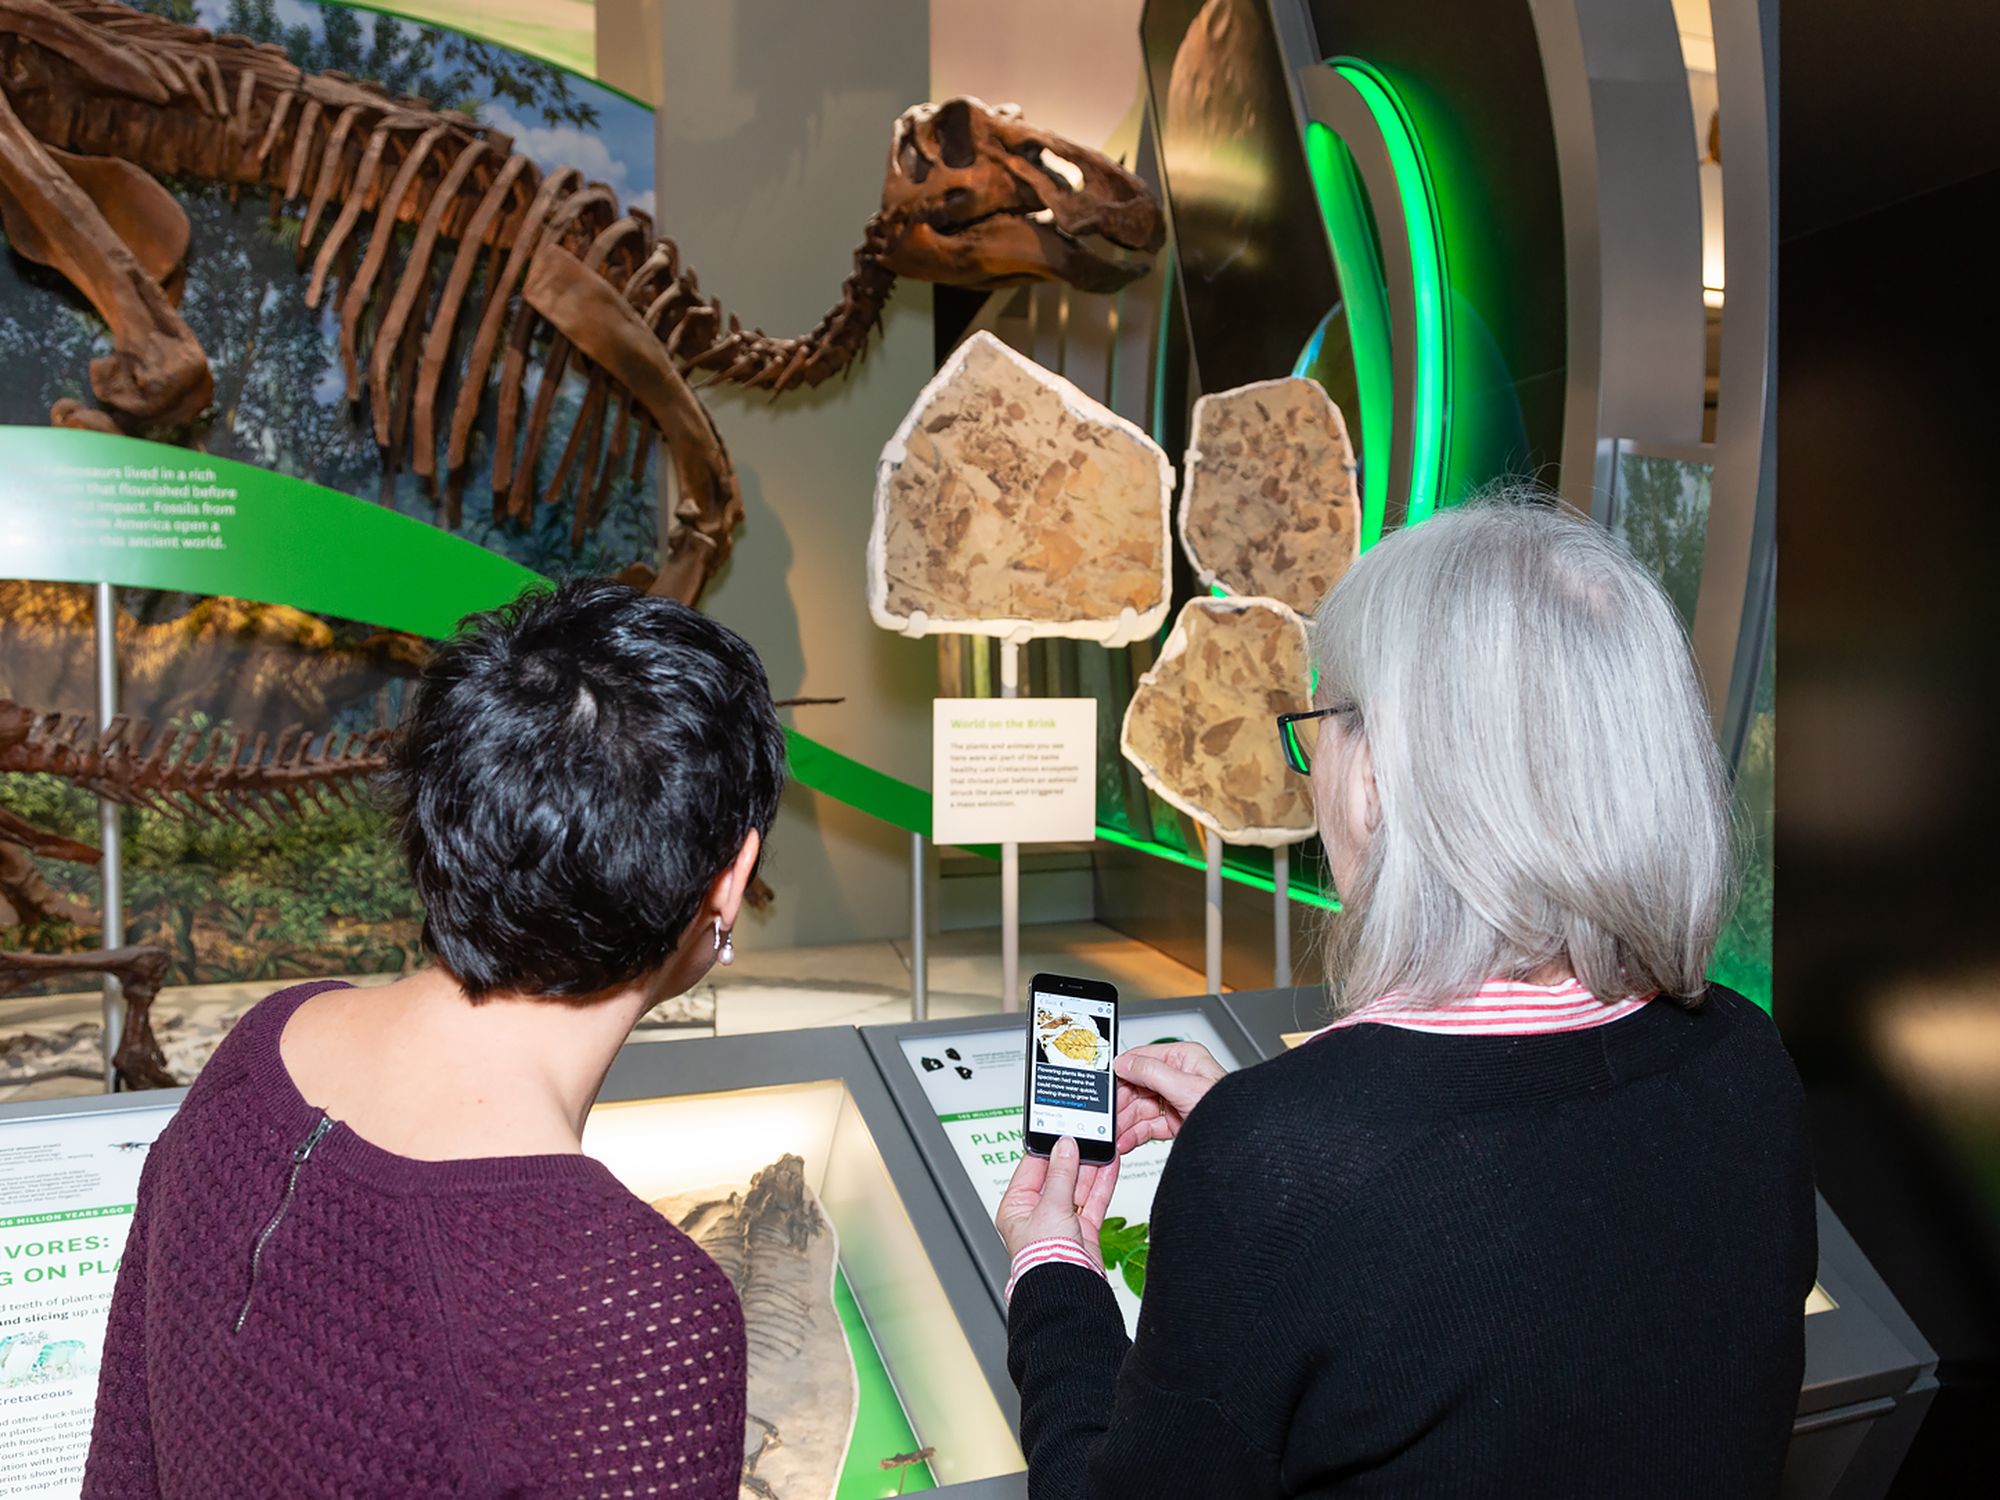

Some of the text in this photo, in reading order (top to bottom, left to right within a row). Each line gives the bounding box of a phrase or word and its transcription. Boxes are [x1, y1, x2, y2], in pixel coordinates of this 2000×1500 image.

[124, 465, 158, 479] lived
[161, 467, 174, 480] in
[177, 470, 186, 480] a
[188, 466, 216, 481] rich
[119, 484, 189, 499] flourished
[192, 486, 237, 499] before
[154, 502, 199, 515] Fossils
[202, 504, 235, 516] from
[114, 518, 171, 532] America
[174, 520, 208, 534] open
[211, 522, 220, 532] a
[128, 536, 180, 549] ancient
[182, 536, 225, 550] world.
[951, 719, 1056, 729] World on the Brink
[966, 743, 988, 751] plants
[1038, 743, 1050, 751] you
[1000, 754, 1016, 762] part
[996, 777, 1009, 785] just
[976, 788, 987, 796] the
[989, 788, 1013, 796] planet
[1031, 787, 1064, 796] triggered
[16, 1214, 61, 1225] MILLION
[64, 1210, 99, 1219] YEARS
[102, 1207, 124, 1215] AGO
[24, 1264, 66, 1283] ON
[10, 1300, 42, 1311] teeth
[46, 1297, 58, 1306] of
[25, 1311, 69, 1324] slicing
[72, 1309, 89, 1318] up
[12, 1415, 39, 1425] other
[19, 1435, 56, 1446] hooves
[42, 1445, 65, 1454] they
[30, 1457, 53, 1467] with
[55, 1454, 79, 1463] their
[30, 1469, 57, 1478] show
[60, 1465, 82, 1474] they
[11, 1486, 22, 1494] to
[25, 1482, 50, 1490] snap
[53, 1477, 68, 1487] off
